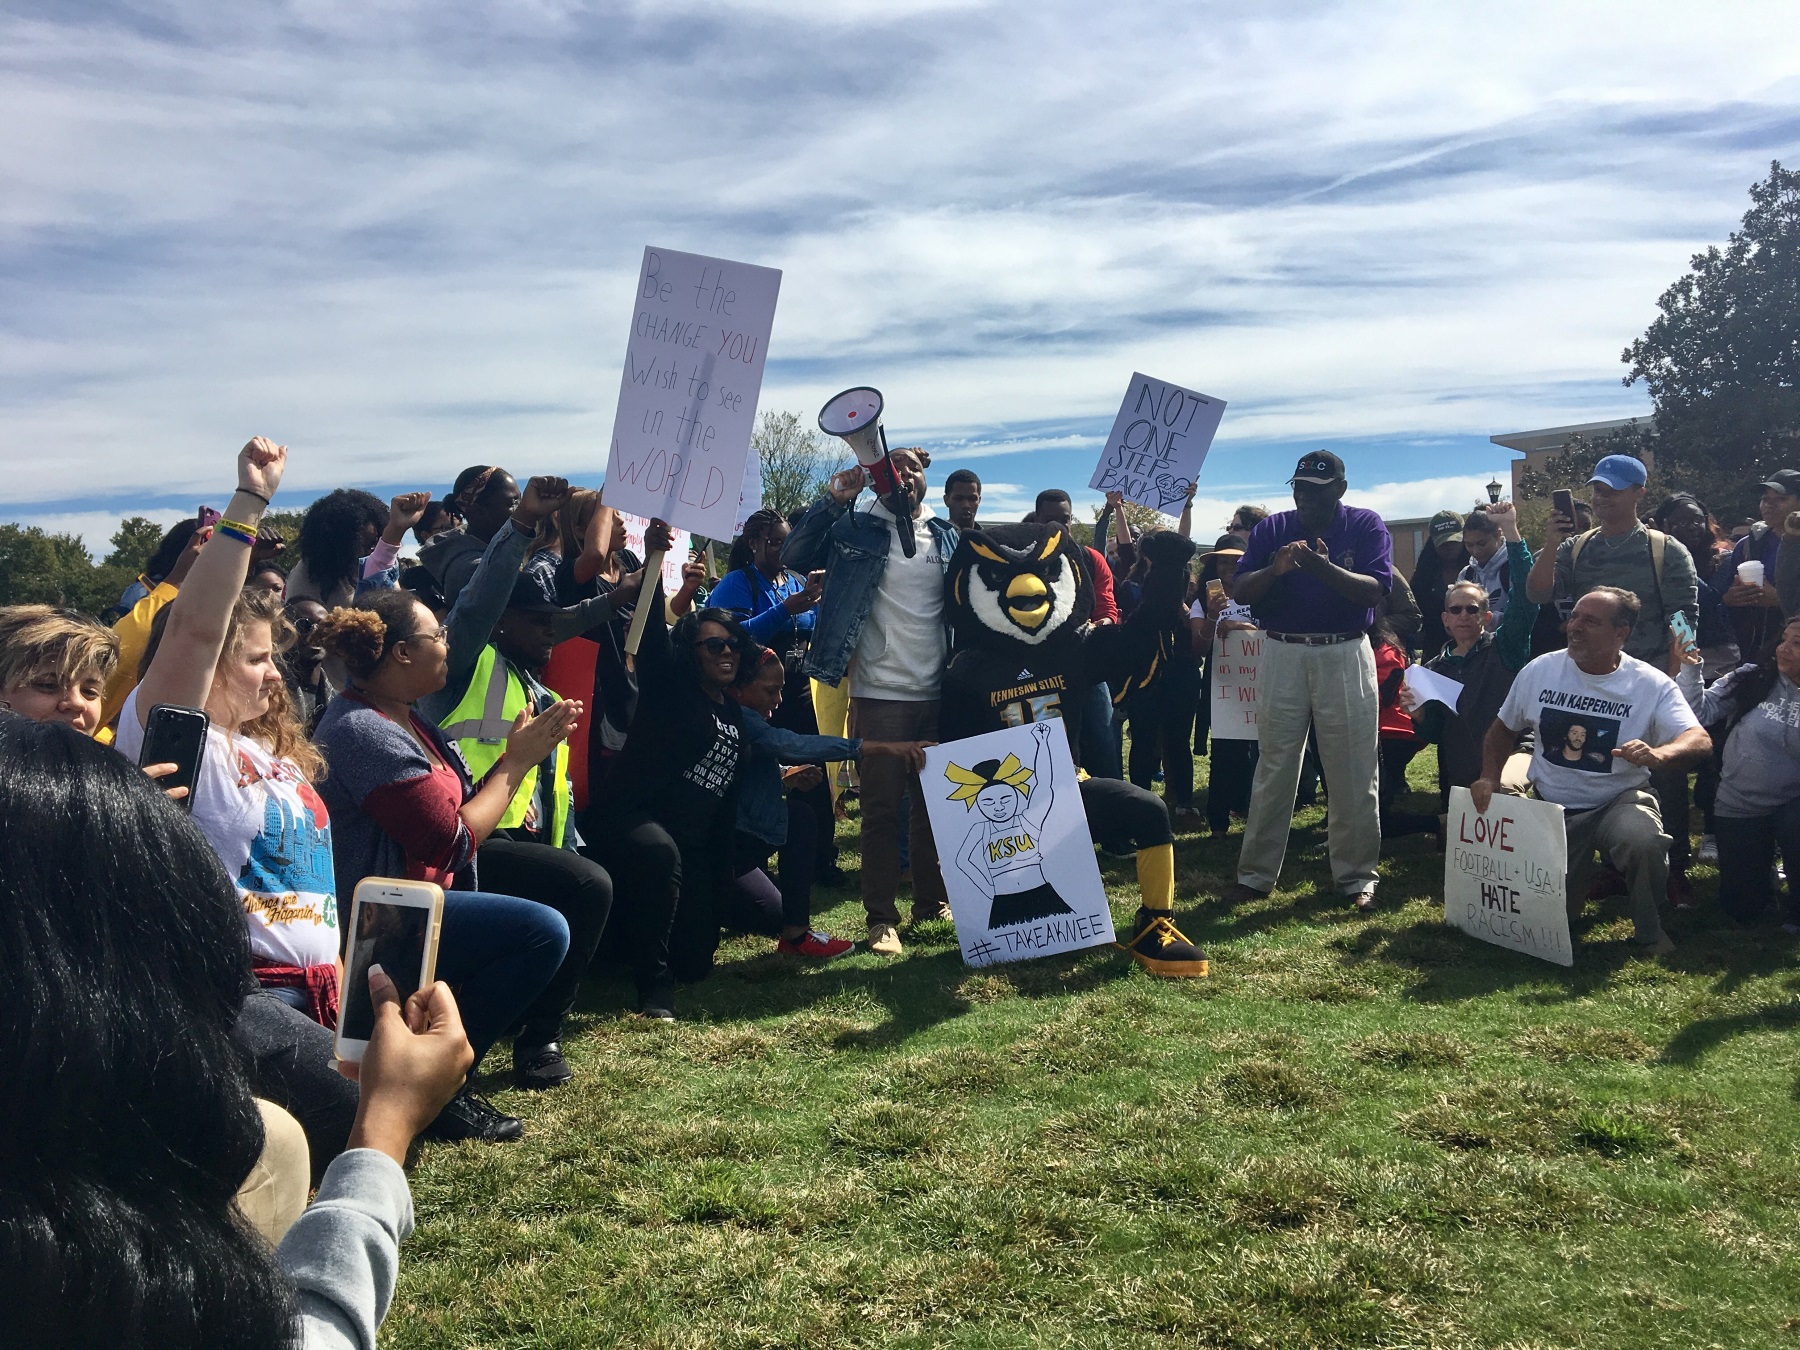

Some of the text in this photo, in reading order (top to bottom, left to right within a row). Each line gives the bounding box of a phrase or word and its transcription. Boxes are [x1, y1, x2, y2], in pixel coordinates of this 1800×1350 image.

[642, 252, 736, 317] Be the
[636, 311, 757, 364] CHANGE YOU
[630, 351, 742, 413] Wish to see
[1134, 384, 1209, 432] NOT
[642, 406, 715, 452] in the
[1124, 419, 1187, 463] ONE
[615, 439, 724, 510] WORLD
[1108, 445, 1170, 478] STEP
[1096, 468, 1156, 505] BACK
[626, 533, 643, 553] mply
[1218, 637, 1264, 657] I WI
[1239, 665, 1257, 681] my
[990, 675, 1067, 707] KENNESAW STATE
[1217, 685, 1256, 702] I WI
[1538, 689, 1633, 718] COLIN KAEPERNICK
[707, 771, 722, 786] HER
[988, 833, 1035, 862] KSU
[1460, 812, 1514, 852] LOVE
[1454, 848, 1512, 881] FOOTBALL
[282, 895, 298, 908] are
[1481, 882, 1521, 914] HATE
[967, 914, 1106, 963] #TAKEAKNEE
